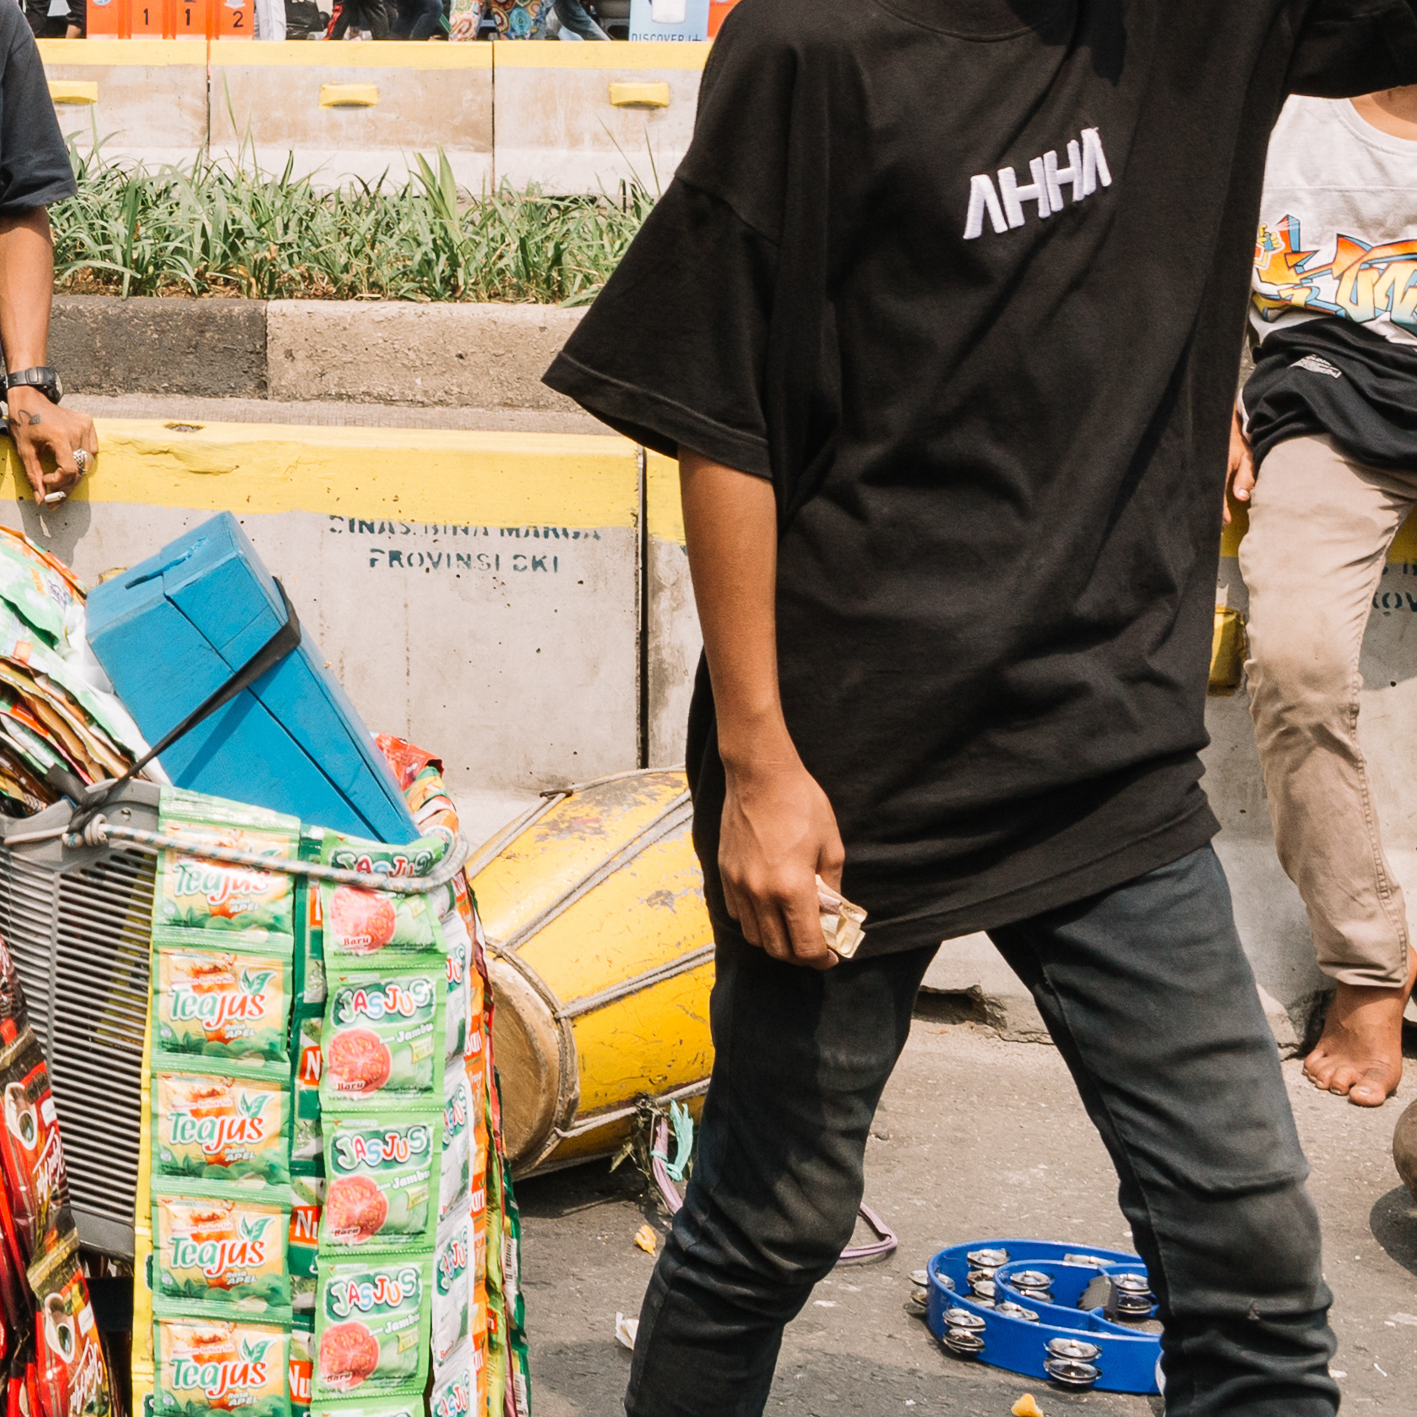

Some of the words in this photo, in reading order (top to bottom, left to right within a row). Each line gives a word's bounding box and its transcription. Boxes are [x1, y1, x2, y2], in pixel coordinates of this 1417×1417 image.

[144, 8, 150, 25] 1
[185, 8, 192, 26] 1
[233, 10, 244, 28] 2
[369, 548, 500, 571] PROVINSI
[343, 936, 370, 946] Baru
[169, 989, 265, 1030] Teajus
[338, 979, 432, 1024] JASJUS
[225, 1029, 255, 1039] APEL
[337, 1081, 365, 1091] Baru
[168, 1112, 263, 1153] Teajus
[225, 1152, 256, 1162] APEL
[335, 1126, 428, 1170] JASJUS
[169, 1237, 265, 1277] Teajus
[227, 1276, 257, 1285] APEL
[330, 1268, 417, 1317] JASJUS
[171, 1359, 267, 1398] Teajus
[228, 1396, 258, 1406] APEL
